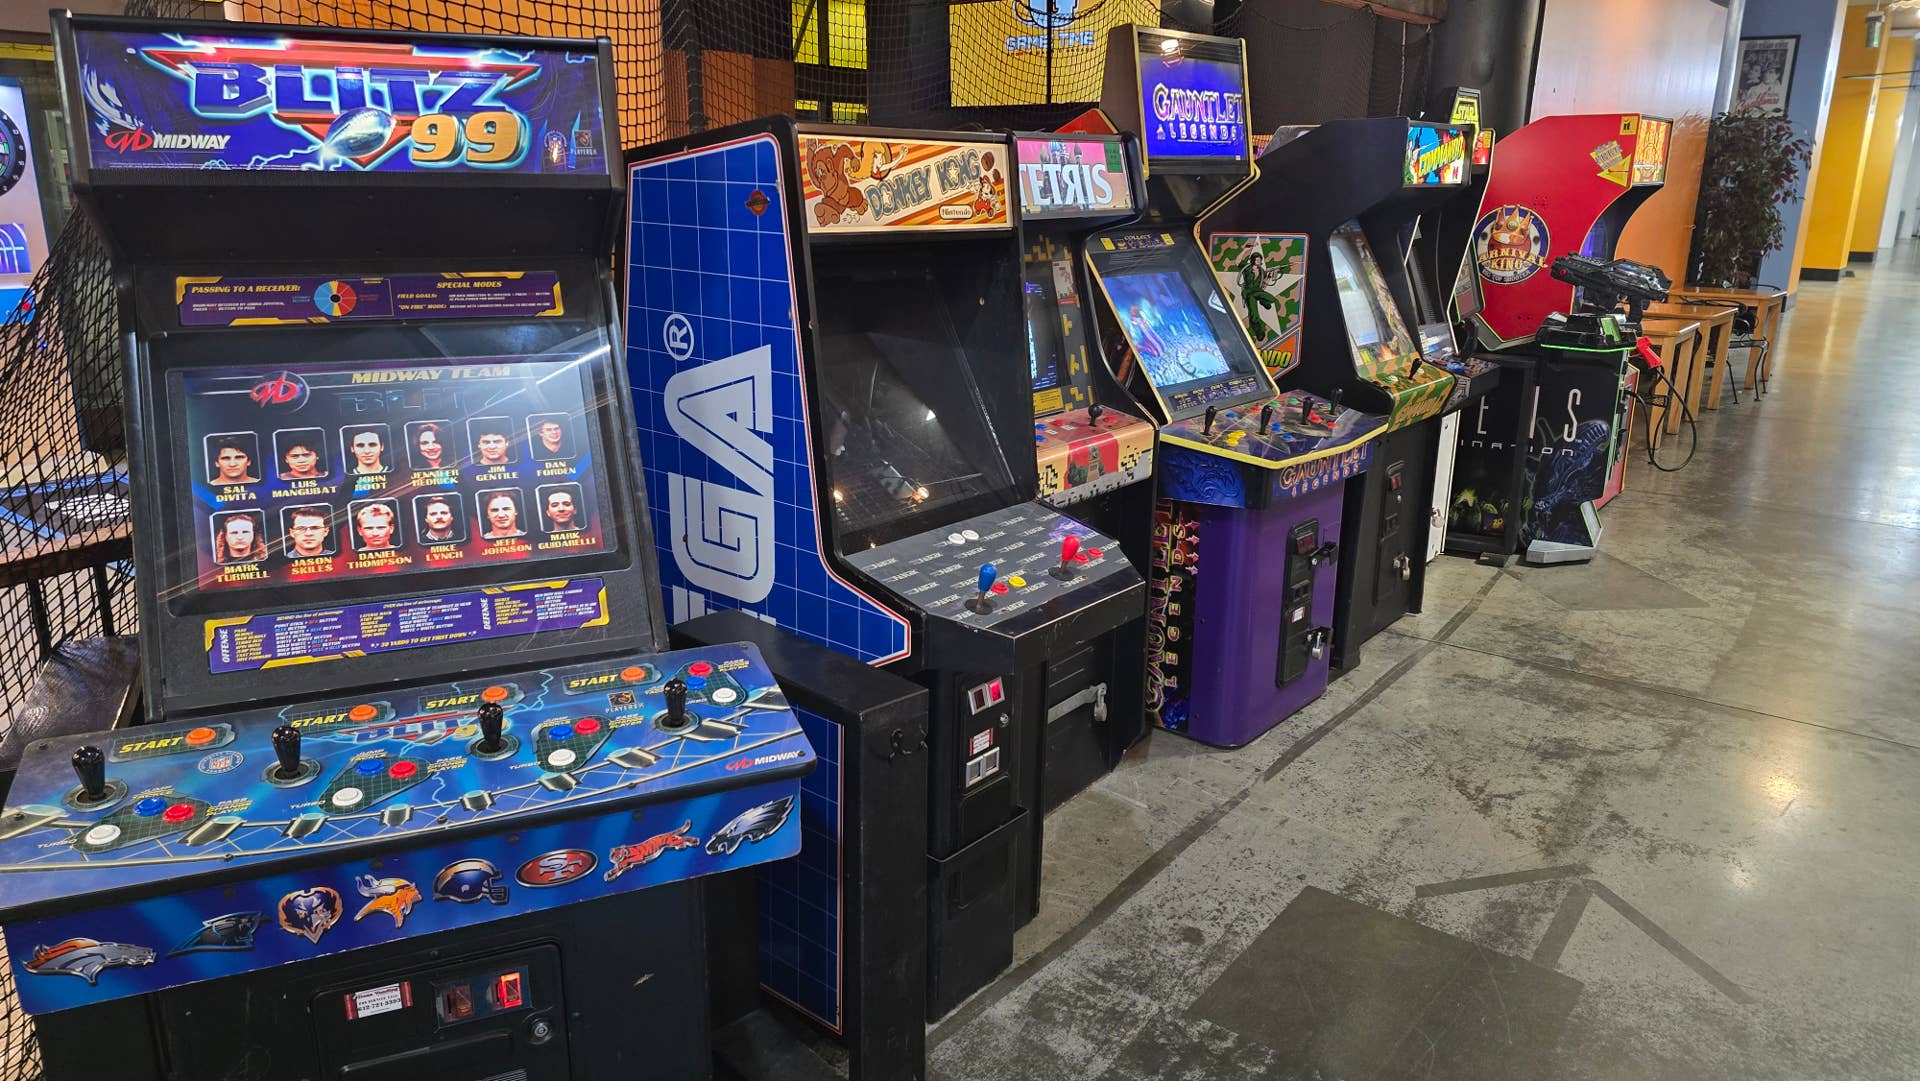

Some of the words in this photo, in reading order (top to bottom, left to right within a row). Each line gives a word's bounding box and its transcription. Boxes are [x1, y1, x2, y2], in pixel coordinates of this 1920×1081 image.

[1005, 34, 1048, 51] GAME
[1057, 31, 1095, 48] TIME
[193, 62, 506, 115] BLITZ
[1153, 82, 1243, 124] GAUNTLET
[1168, 122, 1238, 140] LEGENDS
[152, 134, 231, 149] MIDWAY
[411, 111, 523, 163] 99
[864, 165, 932, 222] DONKEY
[934, 149, 982, 195] KONG
[941, 207, 972, 217] Nintendo
[1478, 247, 1549, 269] ARNIVAL
[1490, 258, 1523, 271] KING
[191, 285, 231, 294] PASSING
[233, 285, 245, 293] TO
[247, 285, 253, 293] A
[255, 284, 301, 293] RECEIVER:
[436, 281, 471, 289] SPECIAL
[473, 280, 503, 288] MODES
[352, 369, 441, 384] MIDWAY
[451, 366, 511, 378] TEAM
[488, 465, 506, 474] JIM
[545, 461, 567, 469] DAN
[1279, 443, 1369, 490] GAUNTLET
[410, 470, 460, 480] JENNIFER
[476, 471, 519, 482] GENTILE
[536, 467, 577, 476] FORDEN
[291, 480, 318, 488] LUIS
[357, 474, 387, 483] JOHN
[223, 485, 248, 494] SAL
[664, 345, 777, 624] GA
[550, 531, 580, 541] MARK
[430, 544, 457, 553] MIKE
[493, 539, 518, 547] JEFF
[358, 550, 397, 561] DANIEL
[482, 544, 532, 556] JOHNSON
[425, 551, 463, 561] LYNCH
[291, 557, 332, 567] JASON
[347, 556, 413, 569] THOMPSON
[223, 563, 260, 574] MARK
[291, 564, 334, 575] SKILES
[216, 571, 270, 583] TURMELL
[219, 628, 230, 663] OFFENSE
[569, 673, 618, 688] START
[425, 694, 480, 710] START
[291, 712, 348, 728] START
[119, 736, 184, 754] START
[754, 750, 800, 766] MIDWAY
[508, 761, 542, 771] TURBO
[290, 800, 326, 809] TURBO
[37, 838, 78, 849] TURBO
